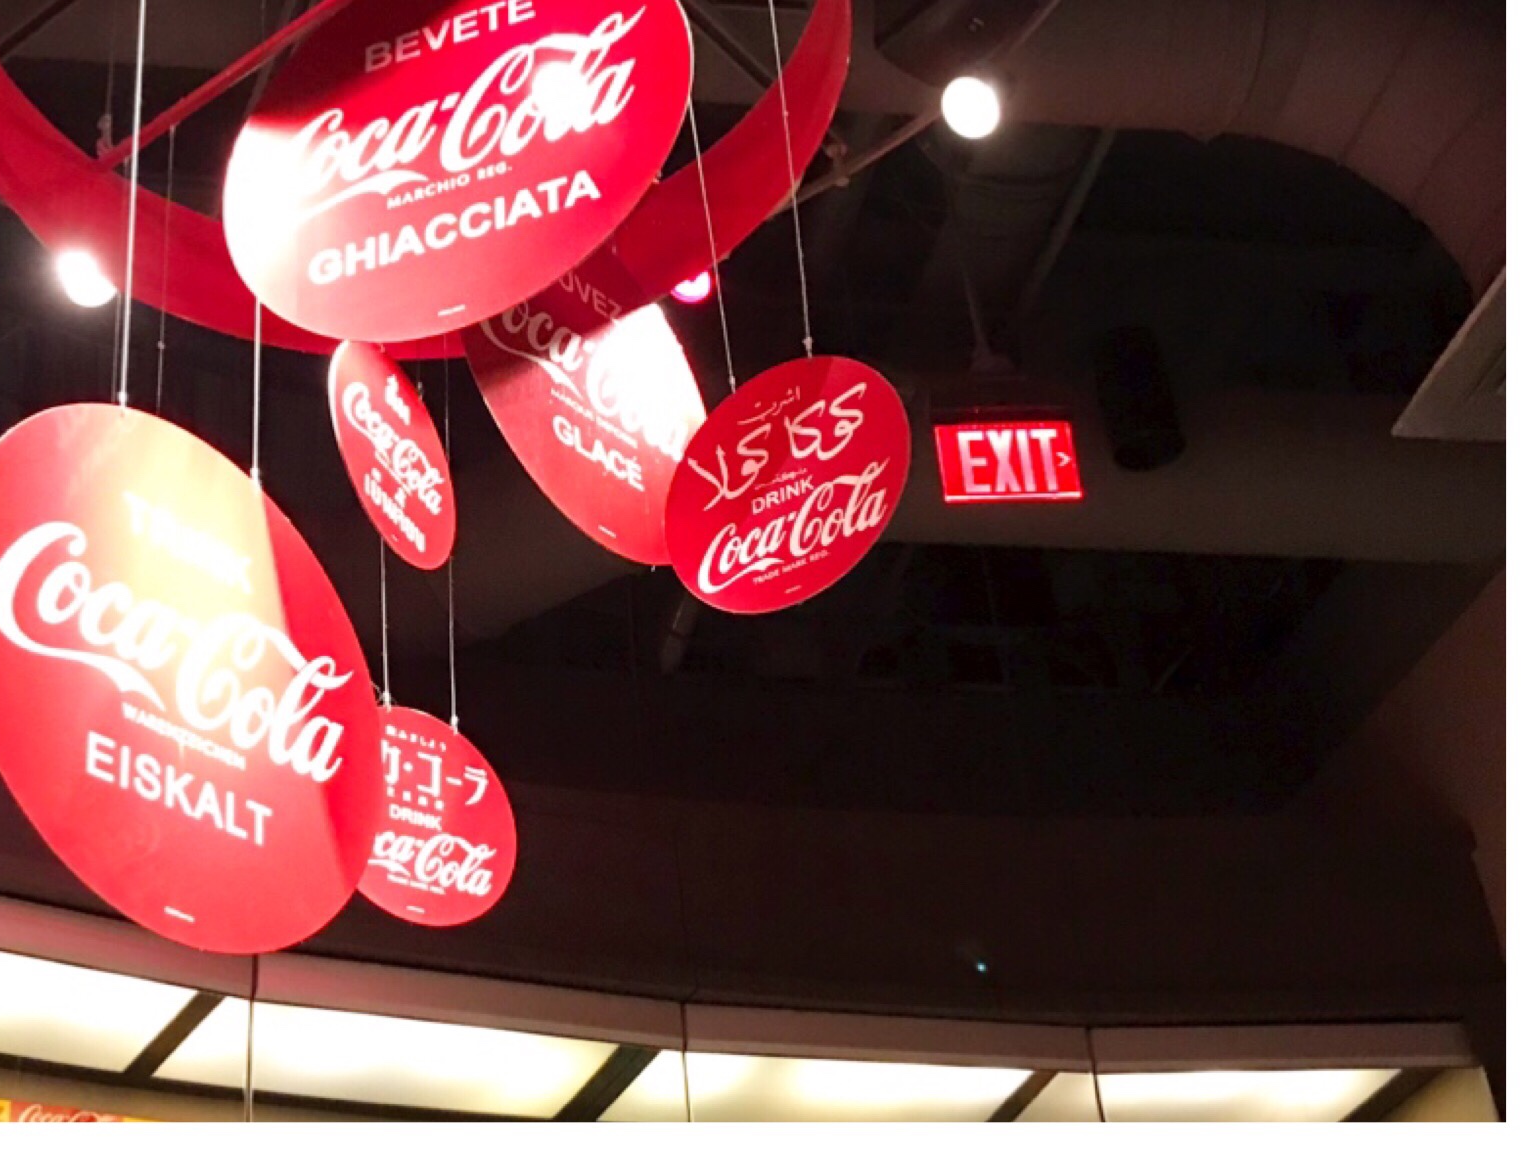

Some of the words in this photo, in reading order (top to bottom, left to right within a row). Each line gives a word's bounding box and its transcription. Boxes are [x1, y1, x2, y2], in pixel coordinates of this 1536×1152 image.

[284, 4, 647, 223] Coca-Cola
[386, 172, 471, 209] MARCHIO
[307, 170, 602, 285] GHIACCIATA
[956, 428, 1059, 493] EXIT
[697, 456, 891, 594] Coca-Cola
[751, 474, 815, 516] DRINK
[85, 730, 274, 847] EISKALT
[381, 739, 489, 806] カ・コーラ
[389, 803, 443, 831] DRINK
[368, 830, 497, 897] ca-Cola
